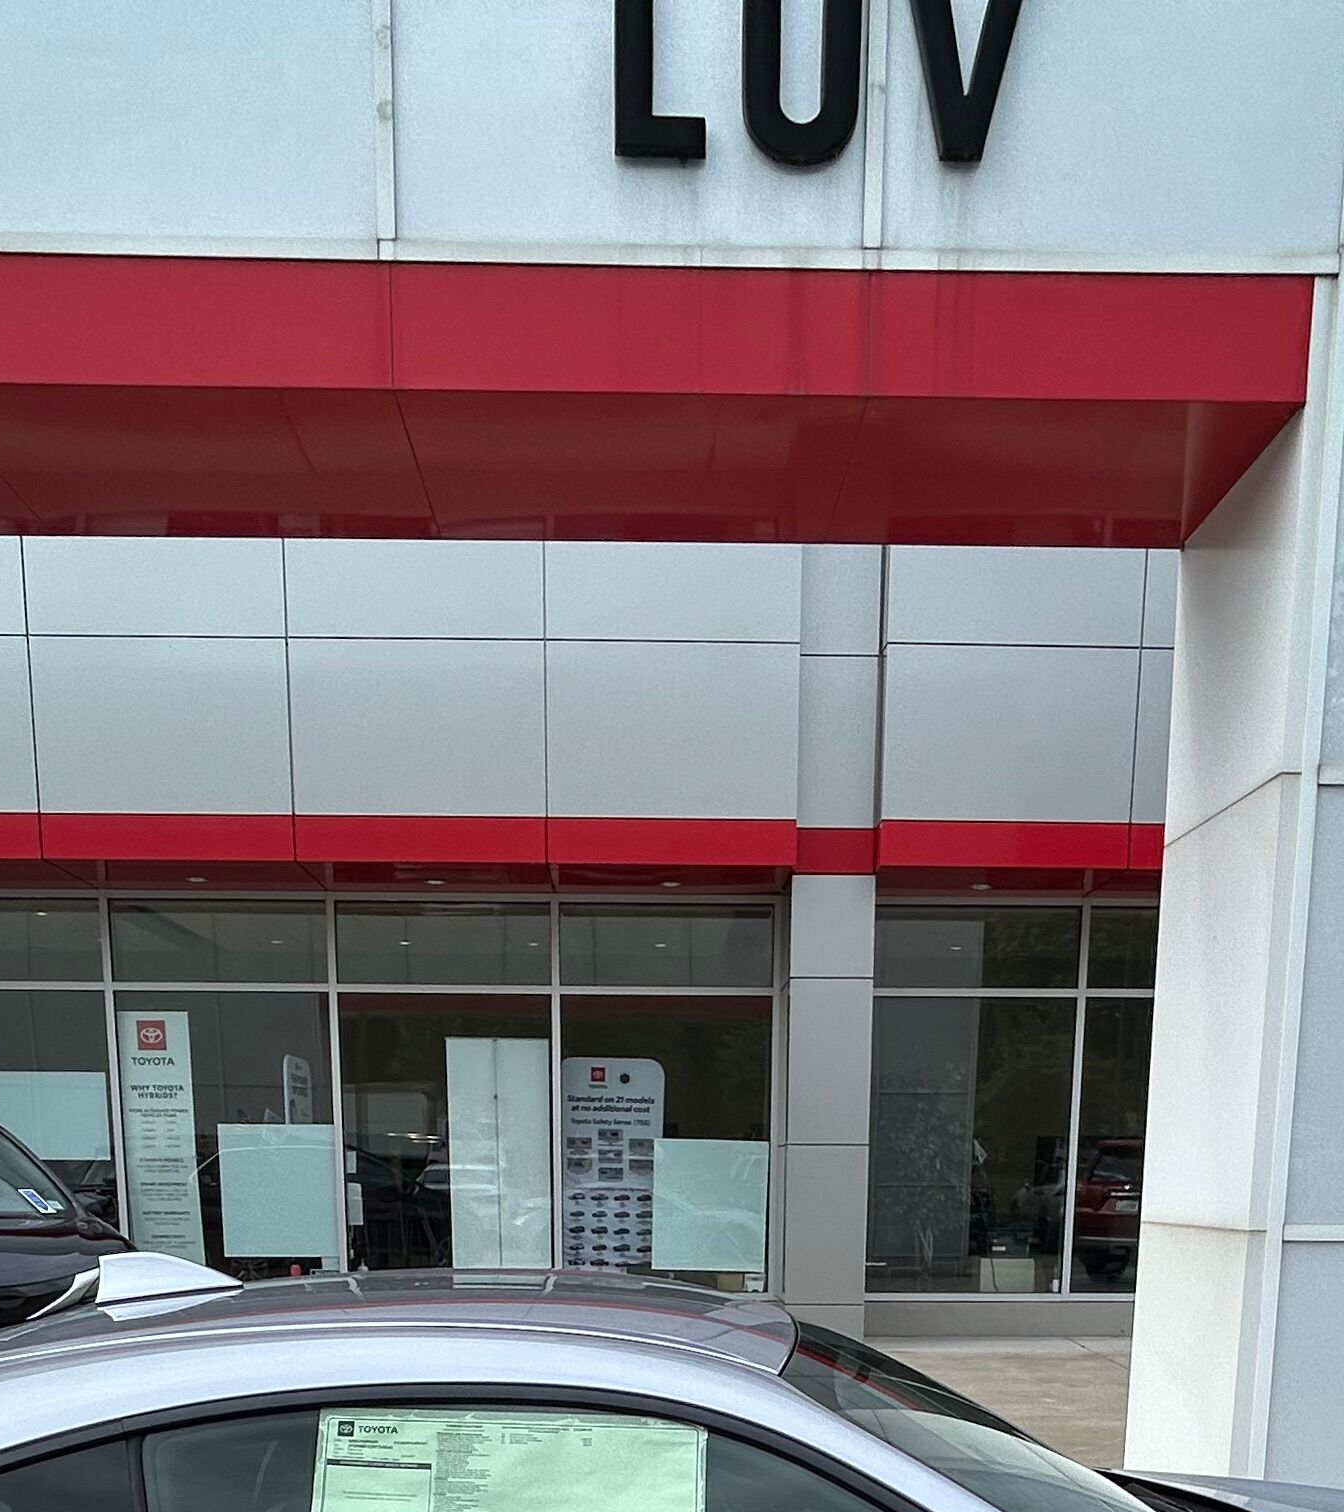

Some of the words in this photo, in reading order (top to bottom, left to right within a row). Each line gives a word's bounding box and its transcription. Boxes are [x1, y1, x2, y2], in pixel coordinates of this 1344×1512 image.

[614, 0, 1023, 166] LUV
[131, 1057, 175, 1066] TOYOTA
[567, 1094, 603, 1103] Standard
[625, 1096, 655, 1104] models
[592, 1104, 633, 1113] additional
[570, 1117, 591, 1125] Toyota
[593, 1118, 612, 1126] Safety
[358, 1425, 398, 1434] TOYOTA
